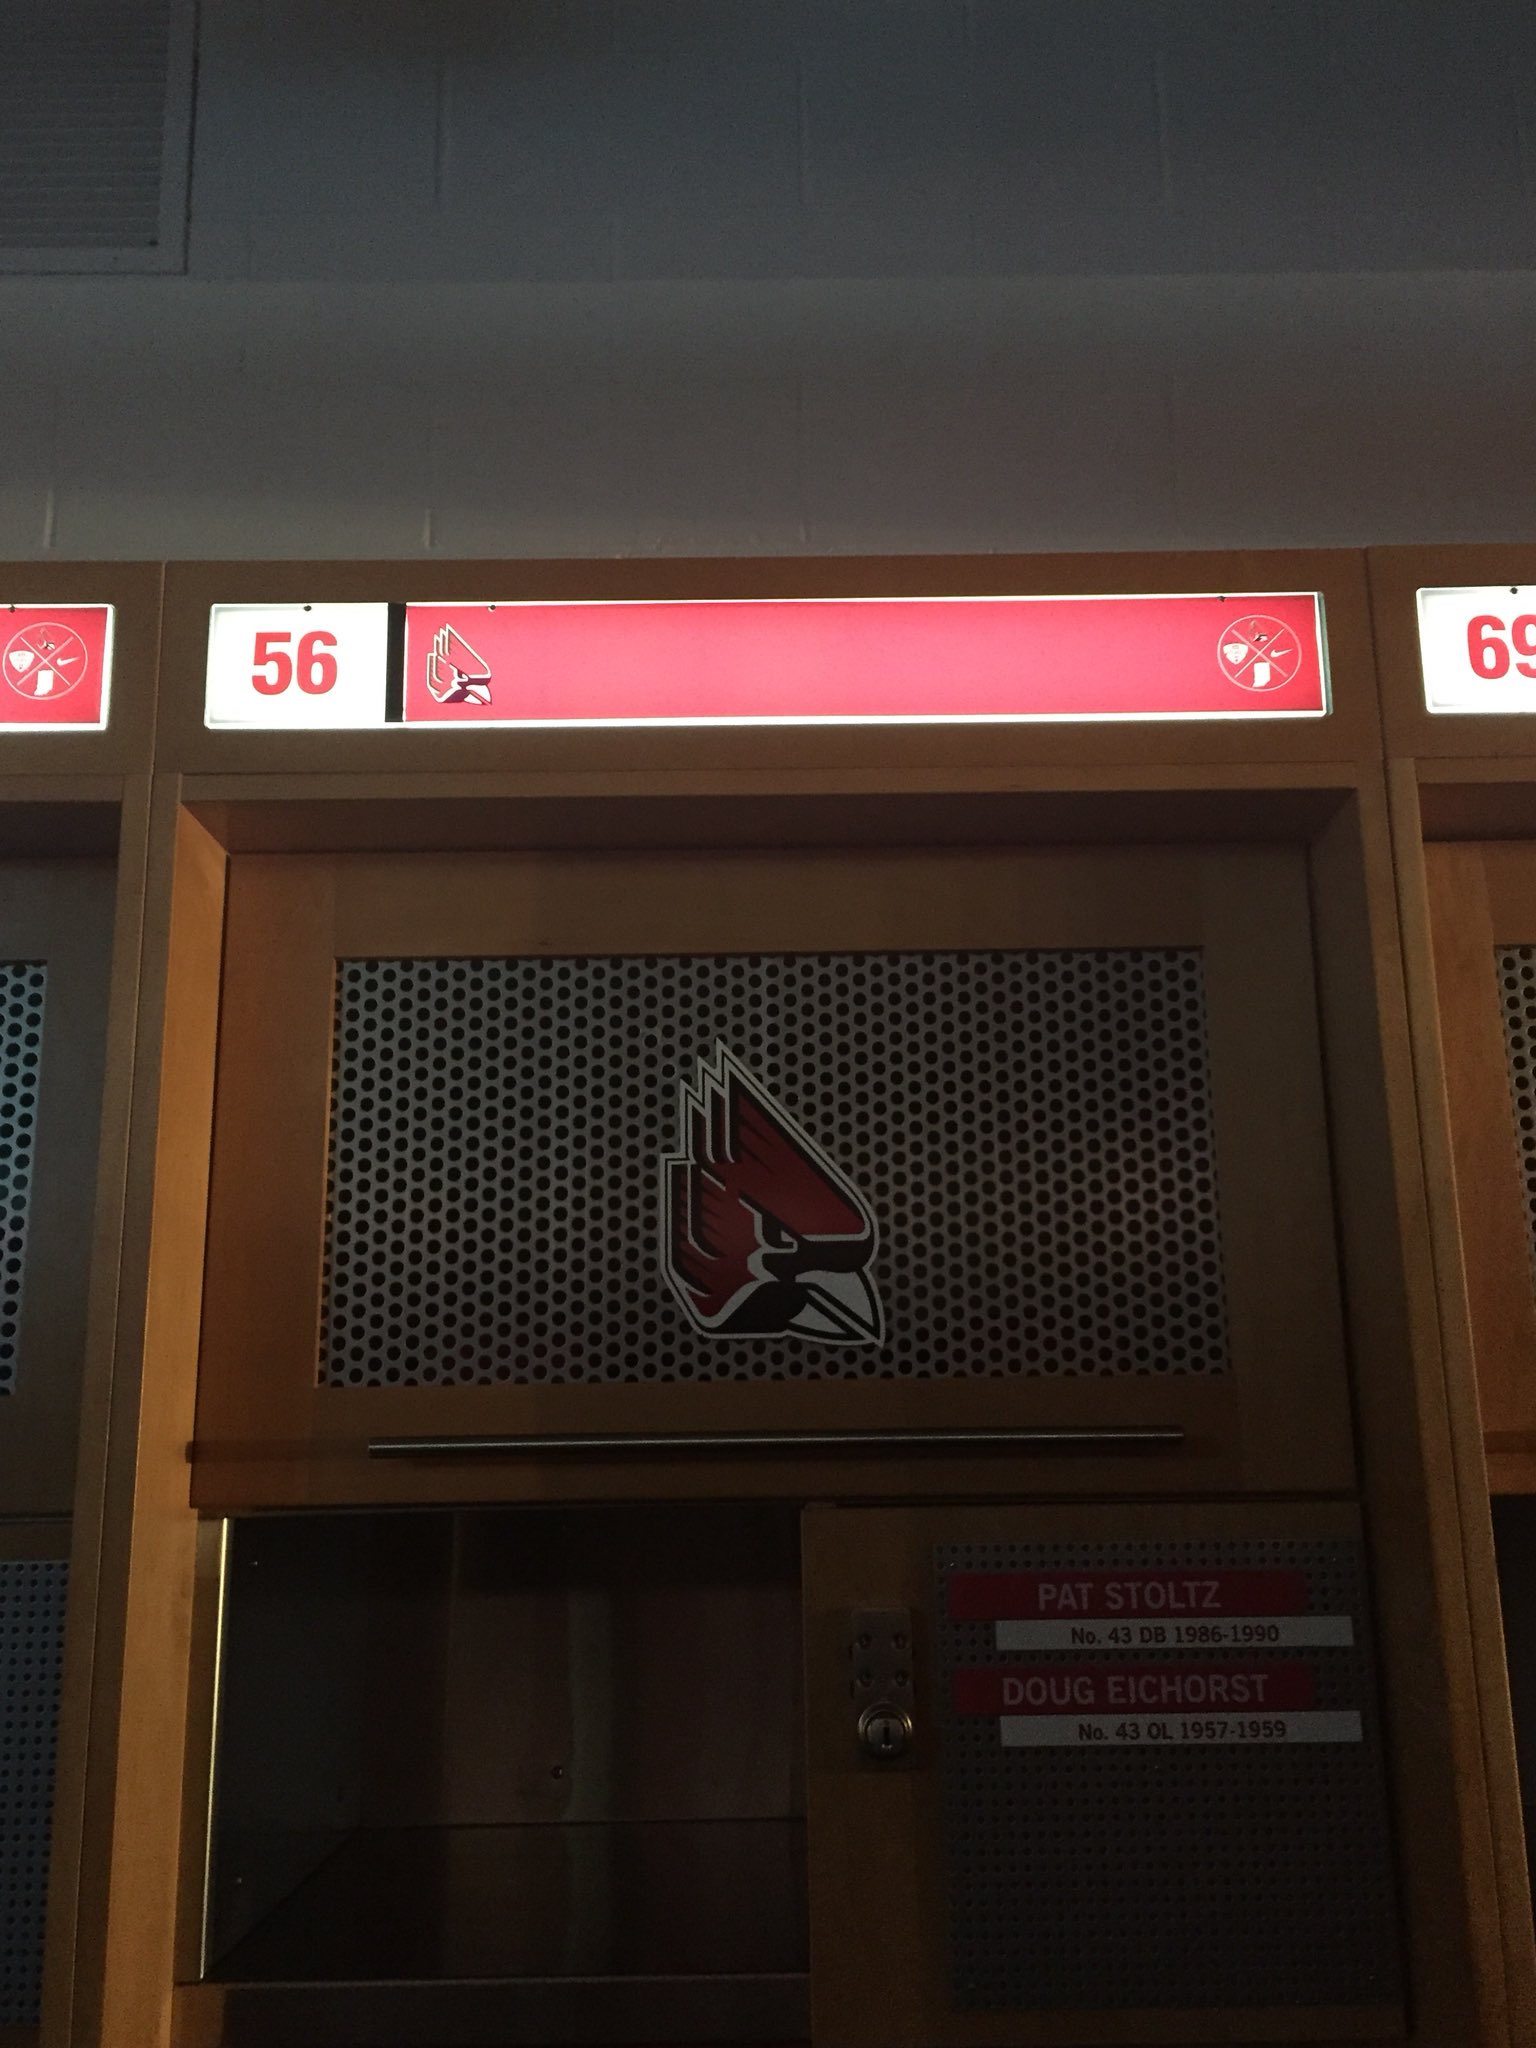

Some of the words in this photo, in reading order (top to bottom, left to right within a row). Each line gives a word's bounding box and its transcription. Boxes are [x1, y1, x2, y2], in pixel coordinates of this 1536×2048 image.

[251, 630, 338, 696] 56
[1038, 1582, 1094, 1612] PAT
[1106, 1580, 1222, 1610] STOLTZ
[1071, 1627, 1102, 1645] No.
[1107, 1626, 1133, 1644] 43
[1139, 1626, 1167, 1644] DB
[1175, 1624, 1280, 1643] 1986-1990
[1002, 1676, 1095, 1706] DOUG
[1108, 1674, 1269, 1705] EICHORST
[1078, 1723, 1107, 1741] No.
[1115, 1723, 1140, 1740] 43
[1147, 1722, 1173, 1740] OL
[1181, 1720, 1287, 1739] 1957-1959
